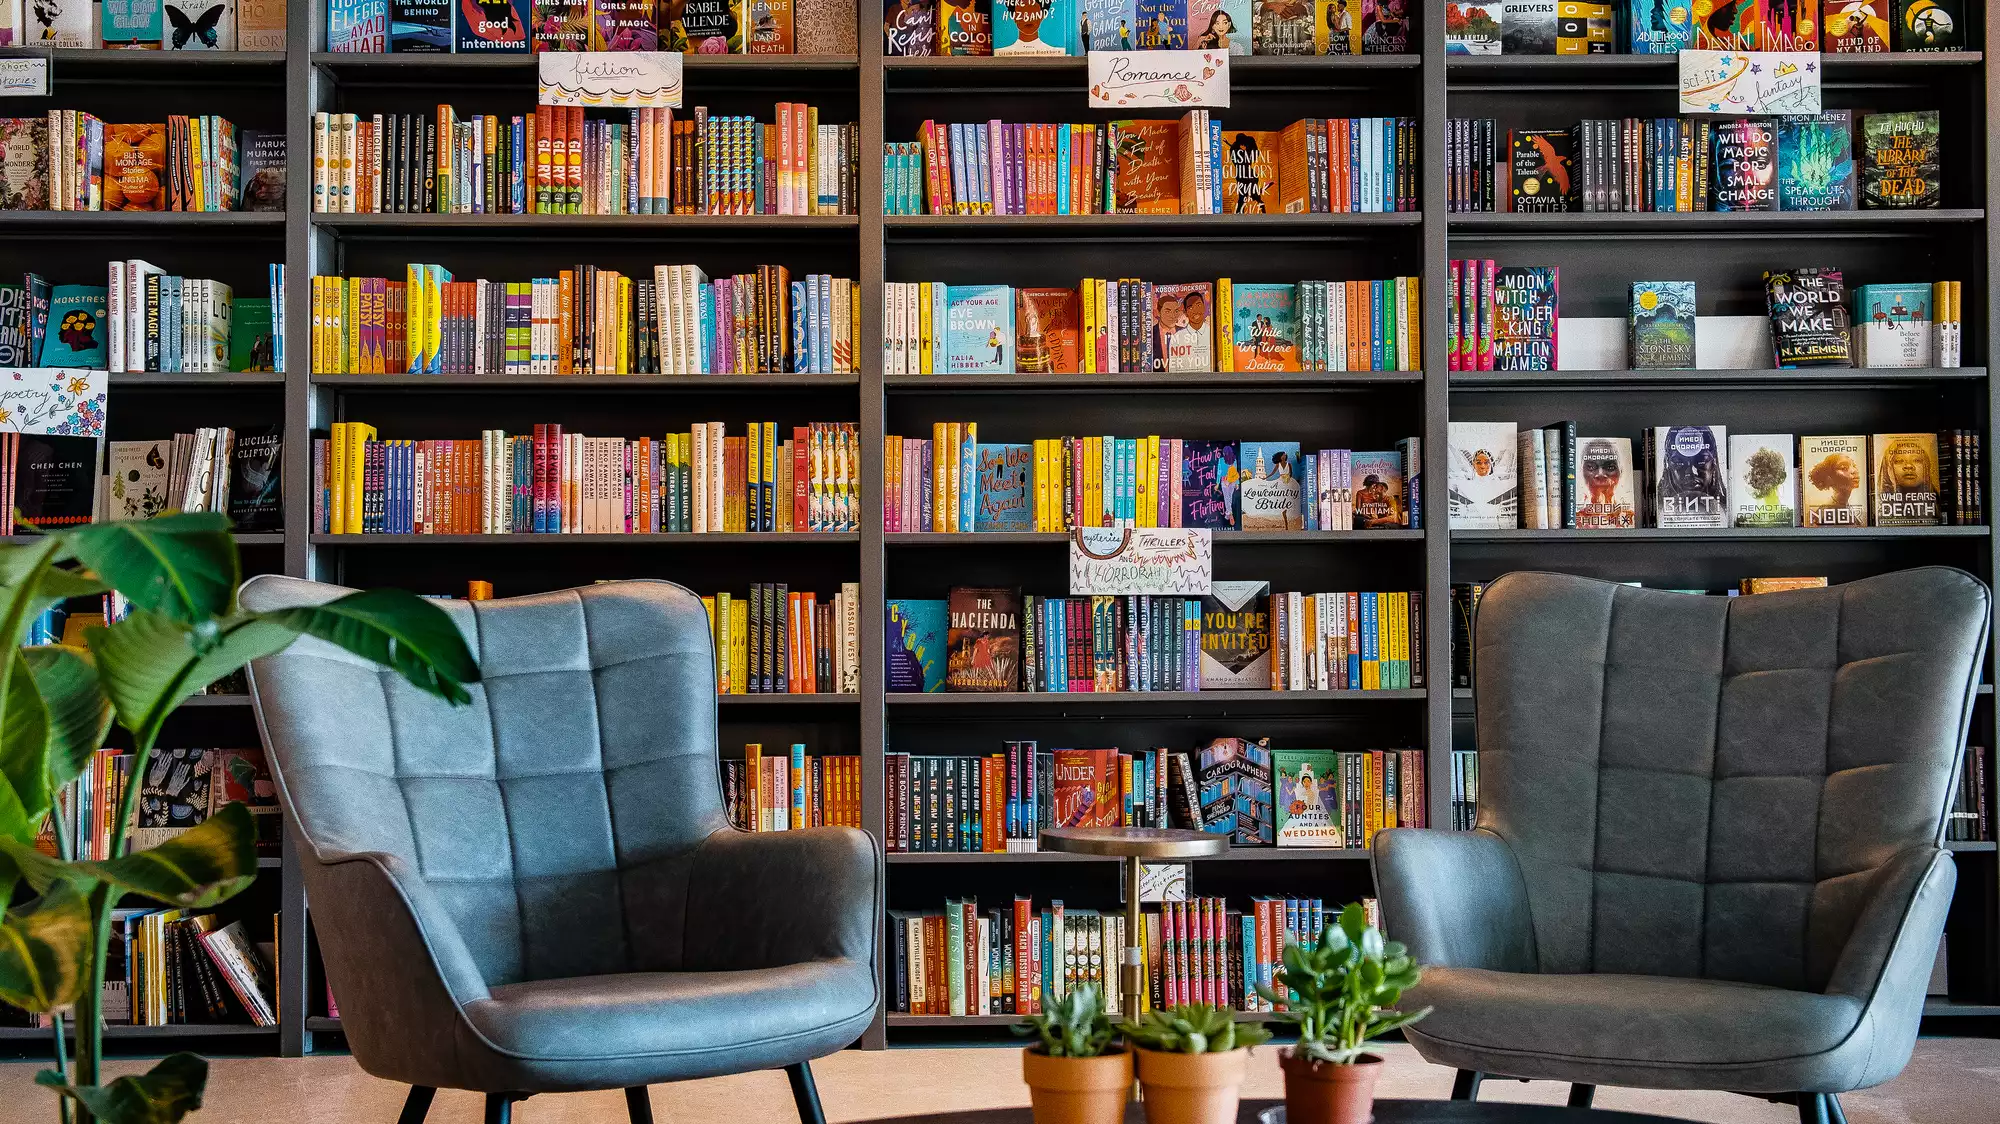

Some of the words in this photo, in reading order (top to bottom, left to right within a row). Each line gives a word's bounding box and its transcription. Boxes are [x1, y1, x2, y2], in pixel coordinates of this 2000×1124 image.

[180, 0, 209, 10] Krak!
[601, 2, 631, 10] GIRLS
[633, 2, 654, 10] MUST
[685, 1, 723, 14] ISABEL
[1140, 4, 1157, 12] Not
[1159, 3, 1175, 12] the
[1505, 4, 1554, 13] GRIEVERS
[404, 8, 439, 16] BEHIND
[955, 12, 989, 23] LOVE
[1003, 8, 1055, 21] HUZBAND?
[113, 15, 150, 29] GLOW
[554, 15, 568, 23] DIE
[351, 16, 385, 39] AYAD
[479, 18, 509, 33] good
[1092, 18, 1120, 34] GAME
[242, 35, 285, 48] GLORY
[535, 32, 586, 40] EXHAUSTED
[753, 32, 781, 42] LAND
[1365, 33, 1406, 44] PRINCESS
[1636, 31, 1689, 43] ADULTHOOD
[1837, 38, 1863, 46] MIND
[1866, 37, 1880, 45] OF
[462, 38, 526, 49] intentions
[1649, 42, 1678, 53] RITES
[2, 60, 29, 71] short
[572, 53, 649, 84] fiction
[1107, 57, 1196, 83] Romance
[0, 75, 37, 85] tories
[1682, 70, 1717, 90] sci-fi
[1782, 114, 1810, 122] SIMON
[1895, 122, 1924, 131] HUCHU
[709, 119, 717, 170] COUNTERFEIT
[1719, 134, 1748, 144] WILL
[1752, 133, 1772, 142] DO
[1890, 136, 1913, 148] THE
[1223, 150, 1273, 164] JASMINE
[1516, 151, 1540, 159] Parable
[1723, 147, 1768, 157] MAGIC
[1876, 149, 1928, 165] LIBRARY
[5, 160, 35, 168] WONDERS
[115, 159, 153, 167] MONTAGE
[1126, 158, 1161, 175] Death
[1733, 162, 1758, 171] FOR
[1222, 164, 1274, 179] GUILLORY
[1900, 165, 1917, 177] THE
[1727, 176, 1766, 186] SMALL
[1785, 186, 1816, 195] SPEAR
[1820, 186, 1844, 194] CUTS
[1881, 180, 1925, 196] DEAD
[1518, 196, 1555, 204] OCTAVIA
[1559, 196, 1567, 204] E.
[1718, 190, 1775, 200] CHANGE
[1790, 196, 1840, 206] THROUGH
[1505, 275, 1544, 288] MOON
[1798, 278, 1823, 287] THE
[149, 276, 158, 306] WHITE
[54, 296, 105, 304] MONSTRES
[1495, 291, 1537, 304] WITCH
[1777, 291, 1840, 305] WORLD
[360, 293, 372, 327] PATSY
[951, 309, 973, 318] EVE
[1503, 307, 1552, 320] SPIDER
[1790, 306, 1813, 316] WE
[148, 309, 157, 337] MAGIC
[950, 320, 996, 330] BROWN
[1509, 321, 1542, 335] KING
[1782, 318, 1834, 332] MAKE
[1249, 325, 1282, 338] While
[1183, 334, 1197, 344] SO
[1170, 345, 1192, 356] NOT
[1494, 342, 1549, 356] MARLON
[1782, 347, 1793, 355] N.
[1794, 347, 1805, 355] K.
[1806, 345, 1847, 355] JEMISIN
[1153, 357, 1185, 370] OVER
[1188, 356, 1209, 368] YOU
[1245, 359, 1285, 371] Dating
[1501, 357, 1548, 370] JAMES
[2, 389, 50, 413] poetry
[240, 435, 278, 446] LUCILLE
[238, 448, 278, 458] CLIFTON
[1244, 488, 1299, 500] Lowcountry
[1880, 493, 1903, 501] WHO
[1905, 492, 1937, 501] FEARS
[982, 495, 1025, 521] Again
[1255, 499, 1292, 509] Bride
[1881, 503, 1935, 517] DEATH
[1809, 507, 1863, 525] NOOR
[1139, 534, 1186, 547] THRILLERS
[977, 599, 991, 609] THE
[952, 613, 1016, 629] HACIENDA
[1204, 612, 1265, 629] YOU'RE
[1202, 633, 1268, 650] INVITED
[1055, 764, 1095, 780] UNDER
[1206, 759, 1268, 780] CARTOGRAPHERS
[1284, 829, 1336, 837] WEDDING
[950, 913, 959, 966] TRUST
